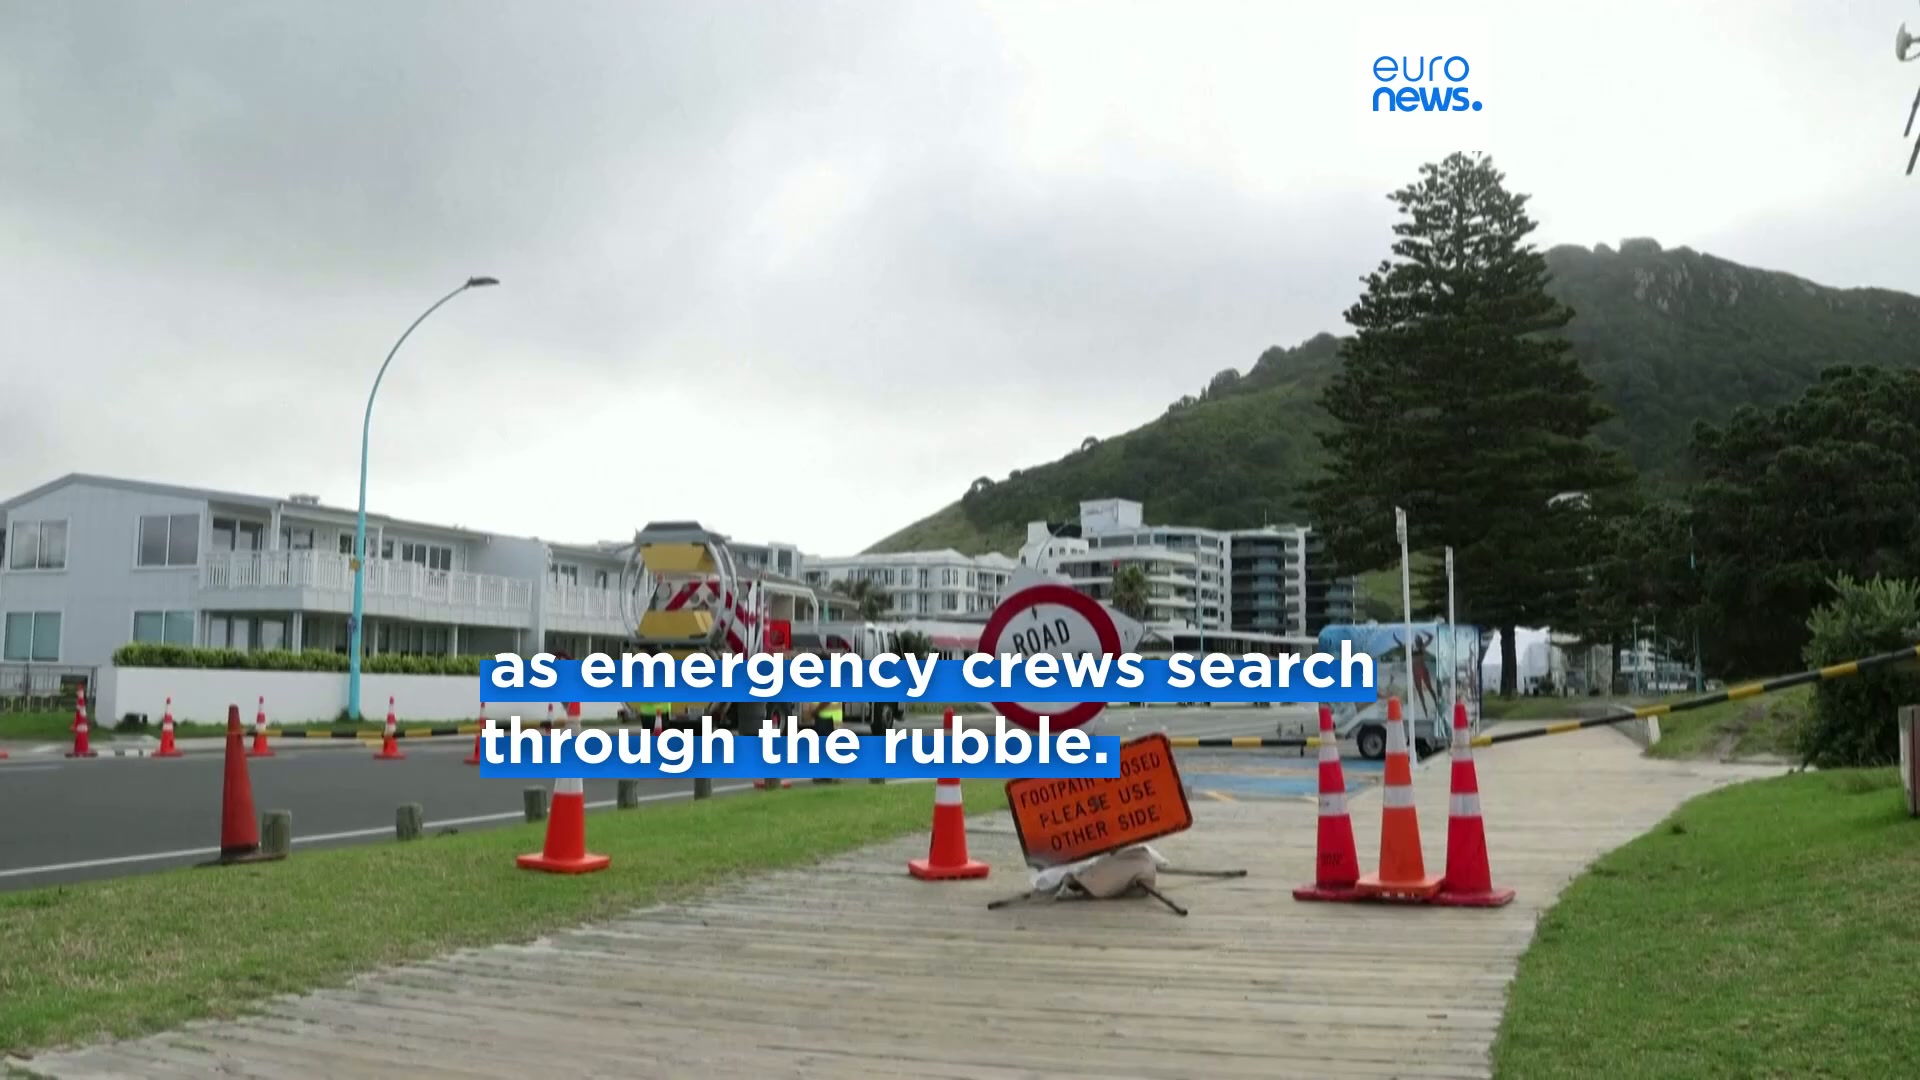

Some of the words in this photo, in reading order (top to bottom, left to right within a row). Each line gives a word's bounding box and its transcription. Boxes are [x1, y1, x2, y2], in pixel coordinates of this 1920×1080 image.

[1013, 618, 1070, 656] ROAD
[1104, 752, 1160, 783] OSED
[1040, 793, 1111, 828] PLEASE
[1118, 780, 1156, 804] USE
[1051, 822, 1108, 851] OTHER
[1118, 804, 1160, 831] SIDE
